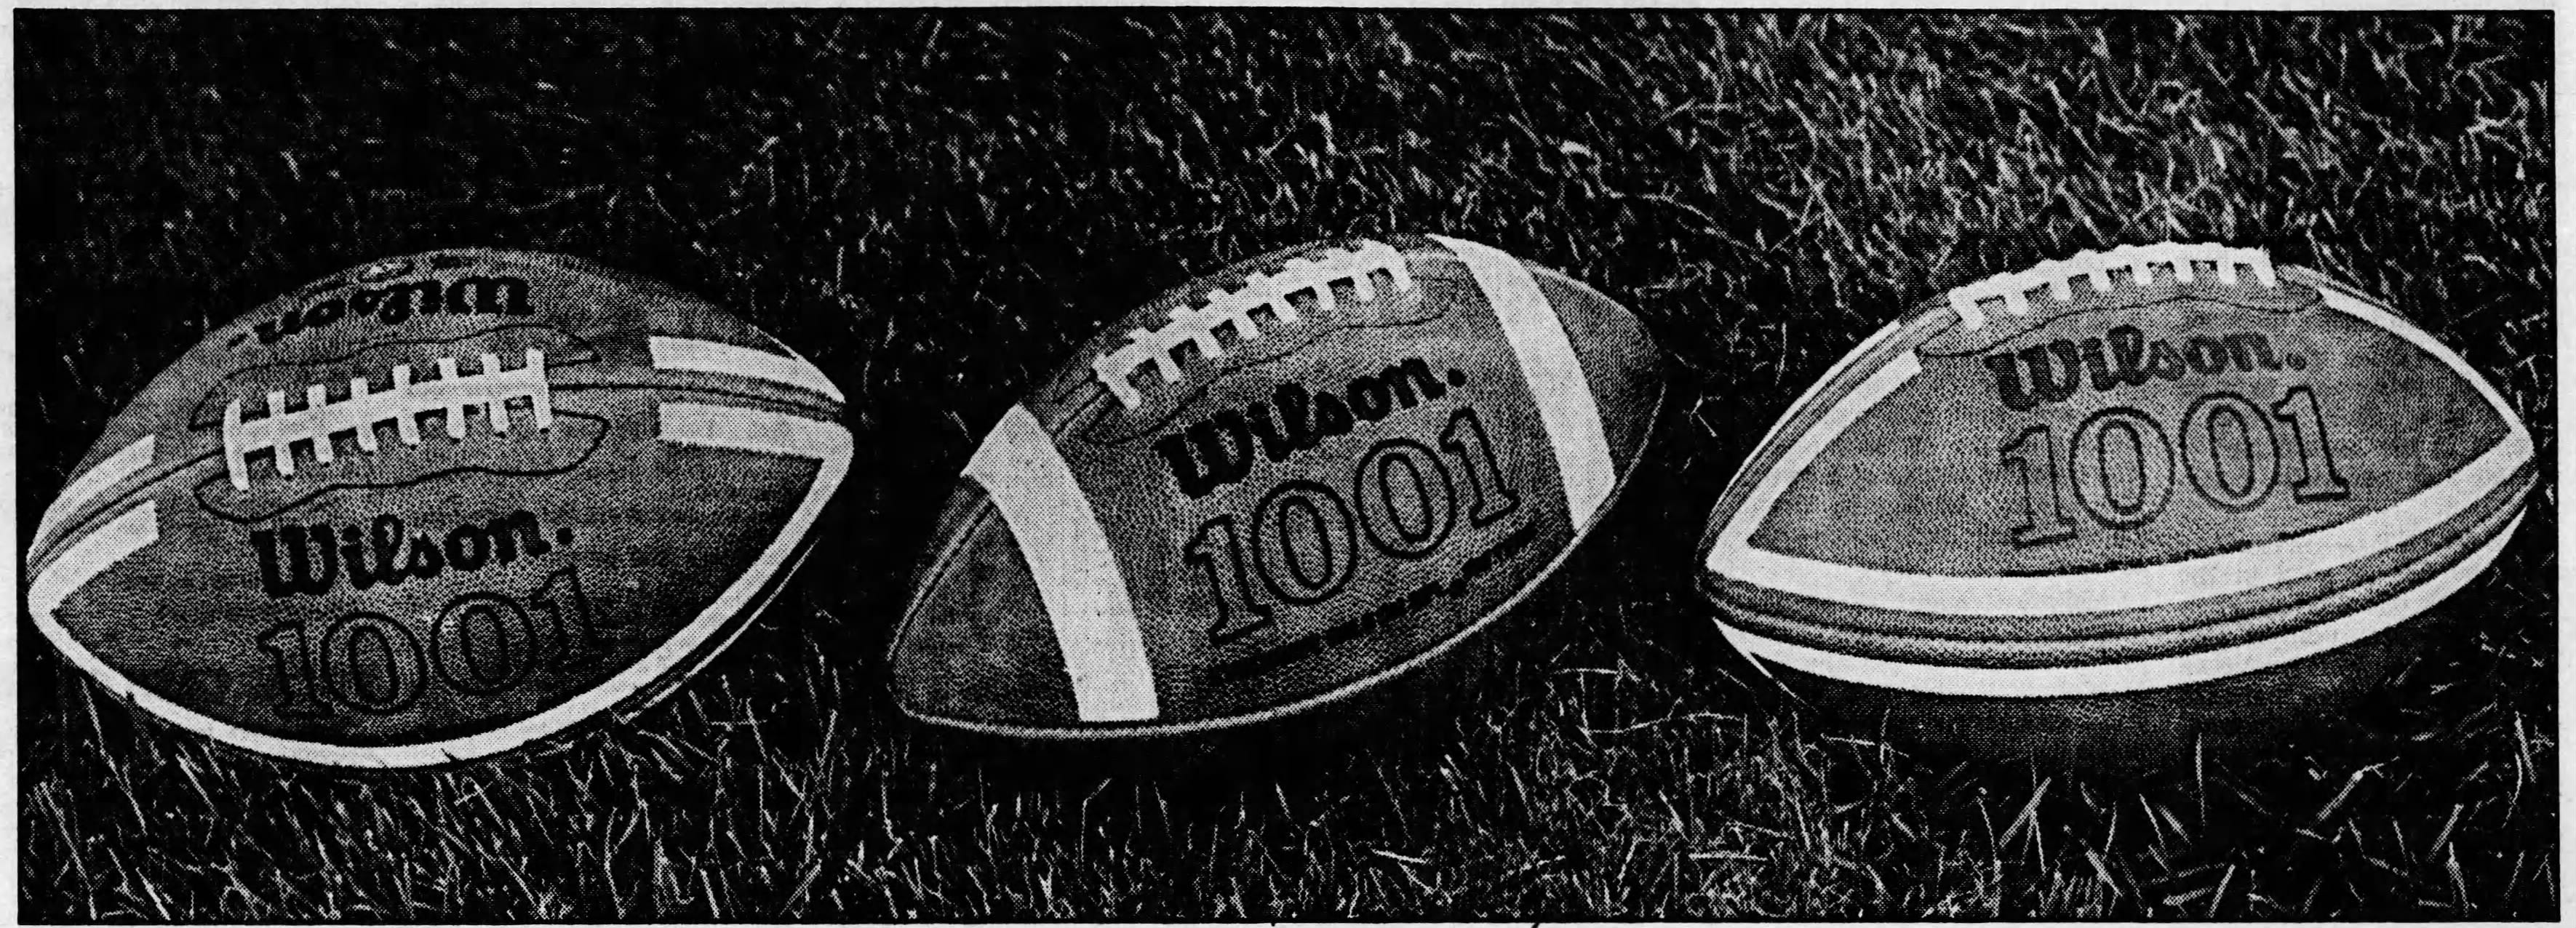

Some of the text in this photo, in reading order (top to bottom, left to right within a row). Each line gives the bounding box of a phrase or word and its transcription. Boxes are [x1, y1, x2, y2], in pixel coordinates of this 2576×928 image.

[1185, 407, 1521, 647] 1001
[2000, 385, 2350, 550] 1001
[257, 565, 599, 719] 1001
